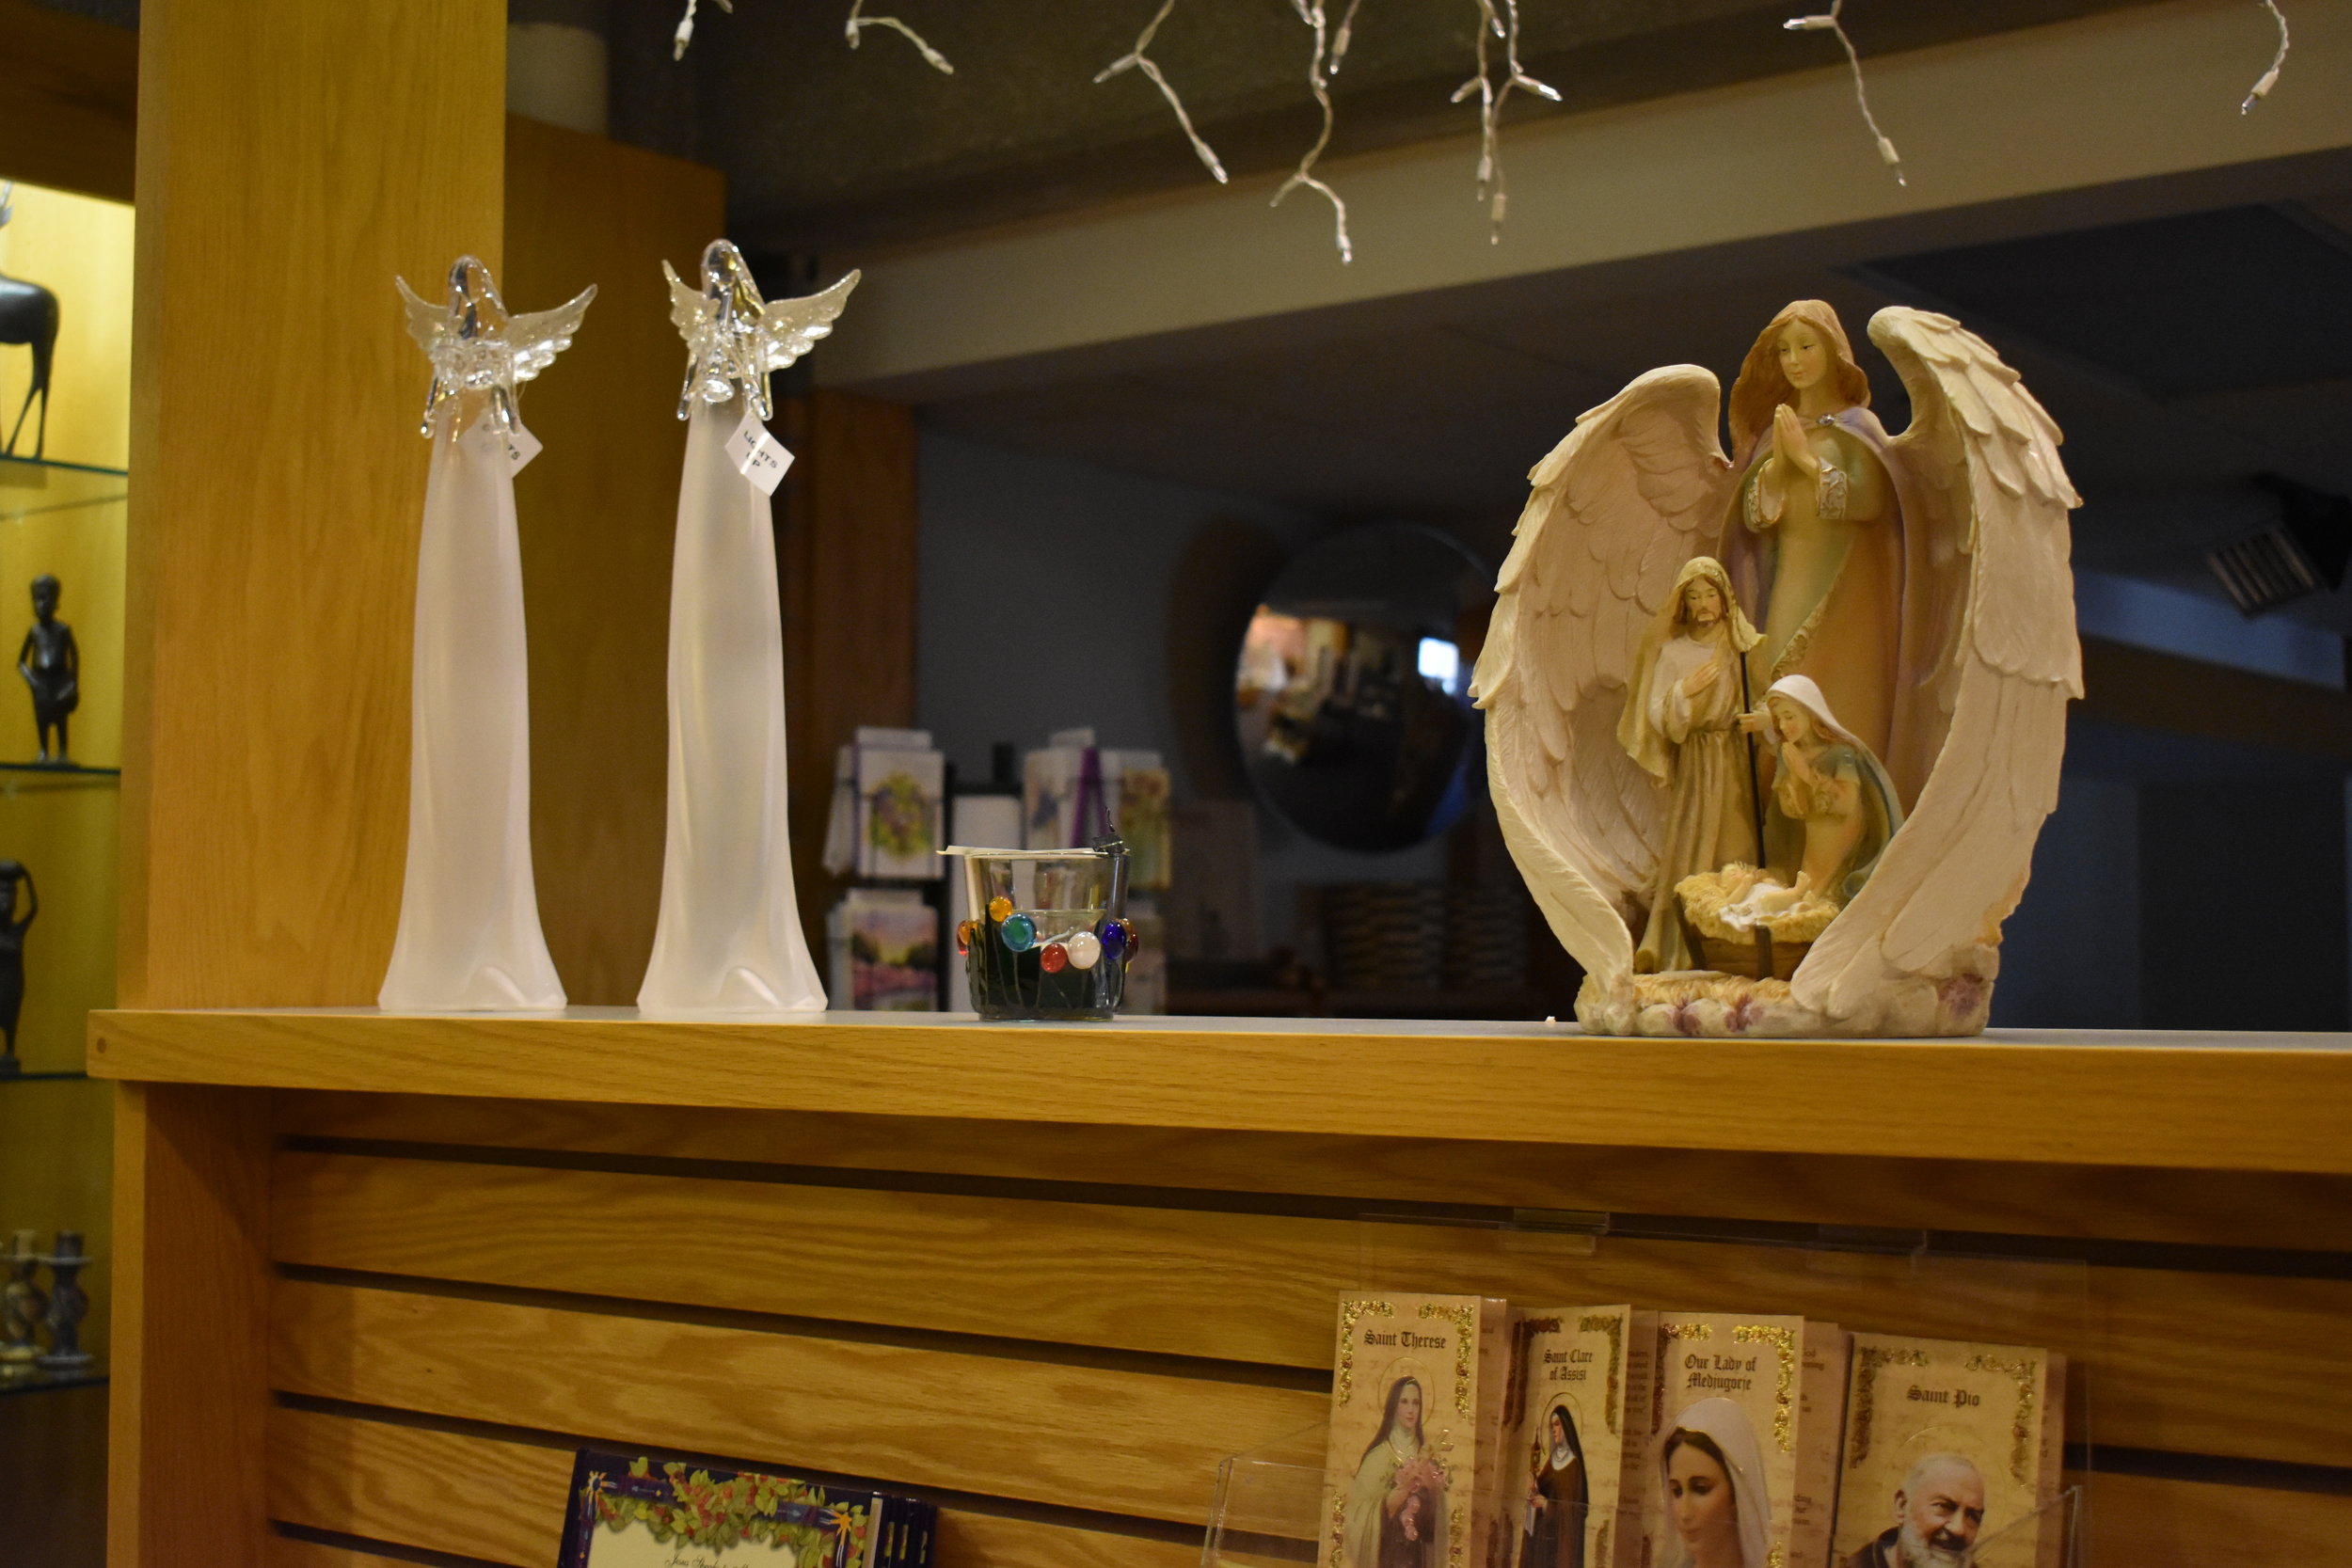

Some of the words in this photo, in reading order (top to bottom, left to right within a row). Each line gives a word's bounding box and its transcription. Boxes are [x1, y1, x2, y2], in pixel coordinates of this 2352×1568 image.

[1363, 1329, 1397, 1346] Saint
[1401, 1331, 1446, 1350] Therese
[1544, 1349, 1567, 1363] Saint
[1569, 1348, 1593, 1363] Clare
[1684, 1354, 1709, 1370] Our
[1713, 1354, 1742, 1371] Lady
[1745, 1356, 1757, 1371] of
[1549, 1367, 1559, 1381] of
[1561, 1366, 1586, 1381] Assisi
[1686, 1372, 1752, 1392] Medjugorje
[1906, 1385, 1948, 1403] Saint
[1952, 1388, 1980, 1408] Pio
